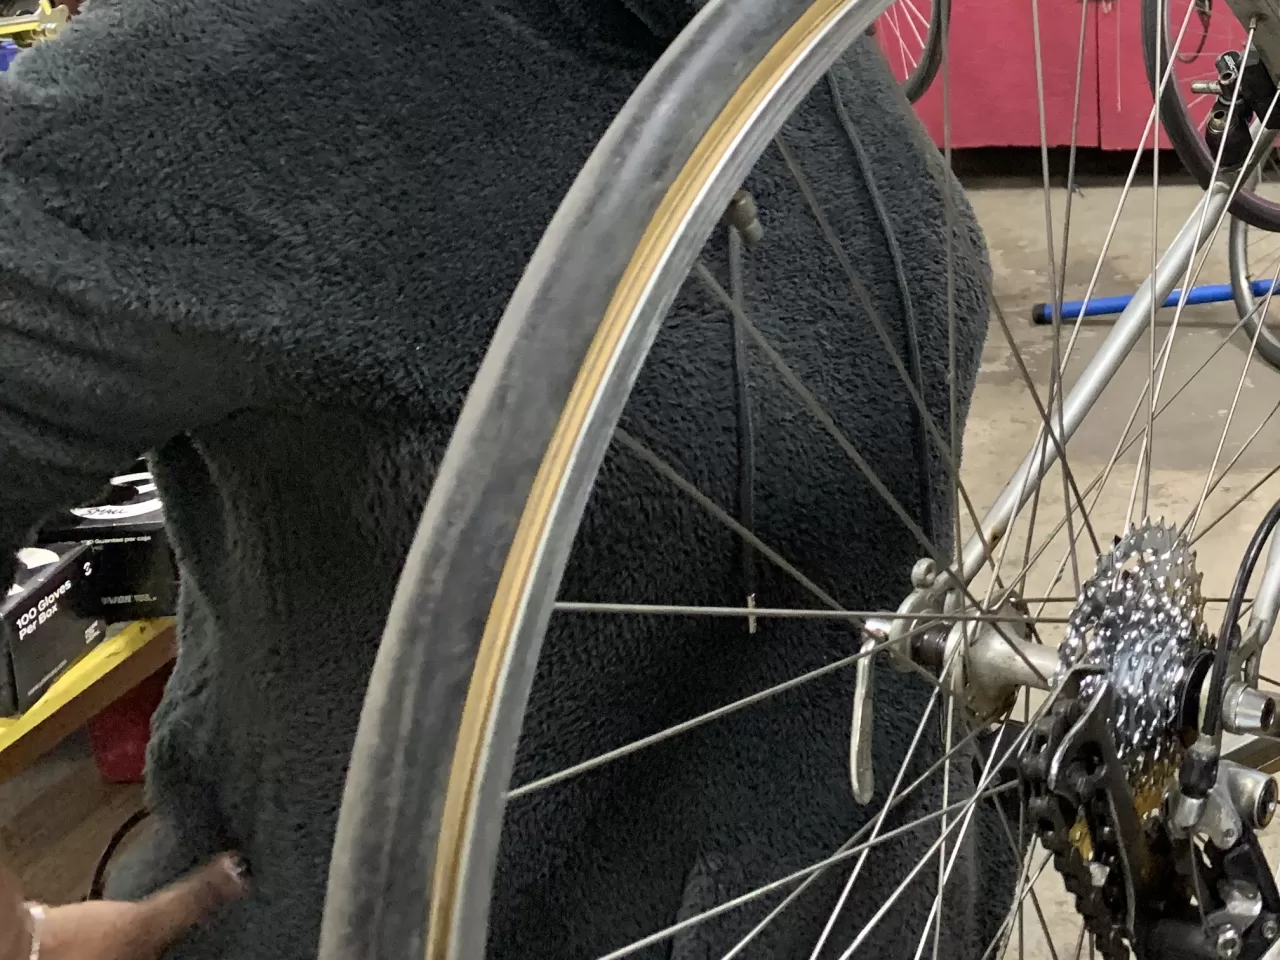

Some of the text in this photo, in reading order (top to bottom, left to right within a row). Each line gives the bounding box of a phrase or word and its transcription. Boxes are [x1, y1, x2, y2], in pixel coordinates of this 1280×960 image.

[16, 580, 72, 629] 100 Gloves
[18, 603, 59, 641] Per Box
